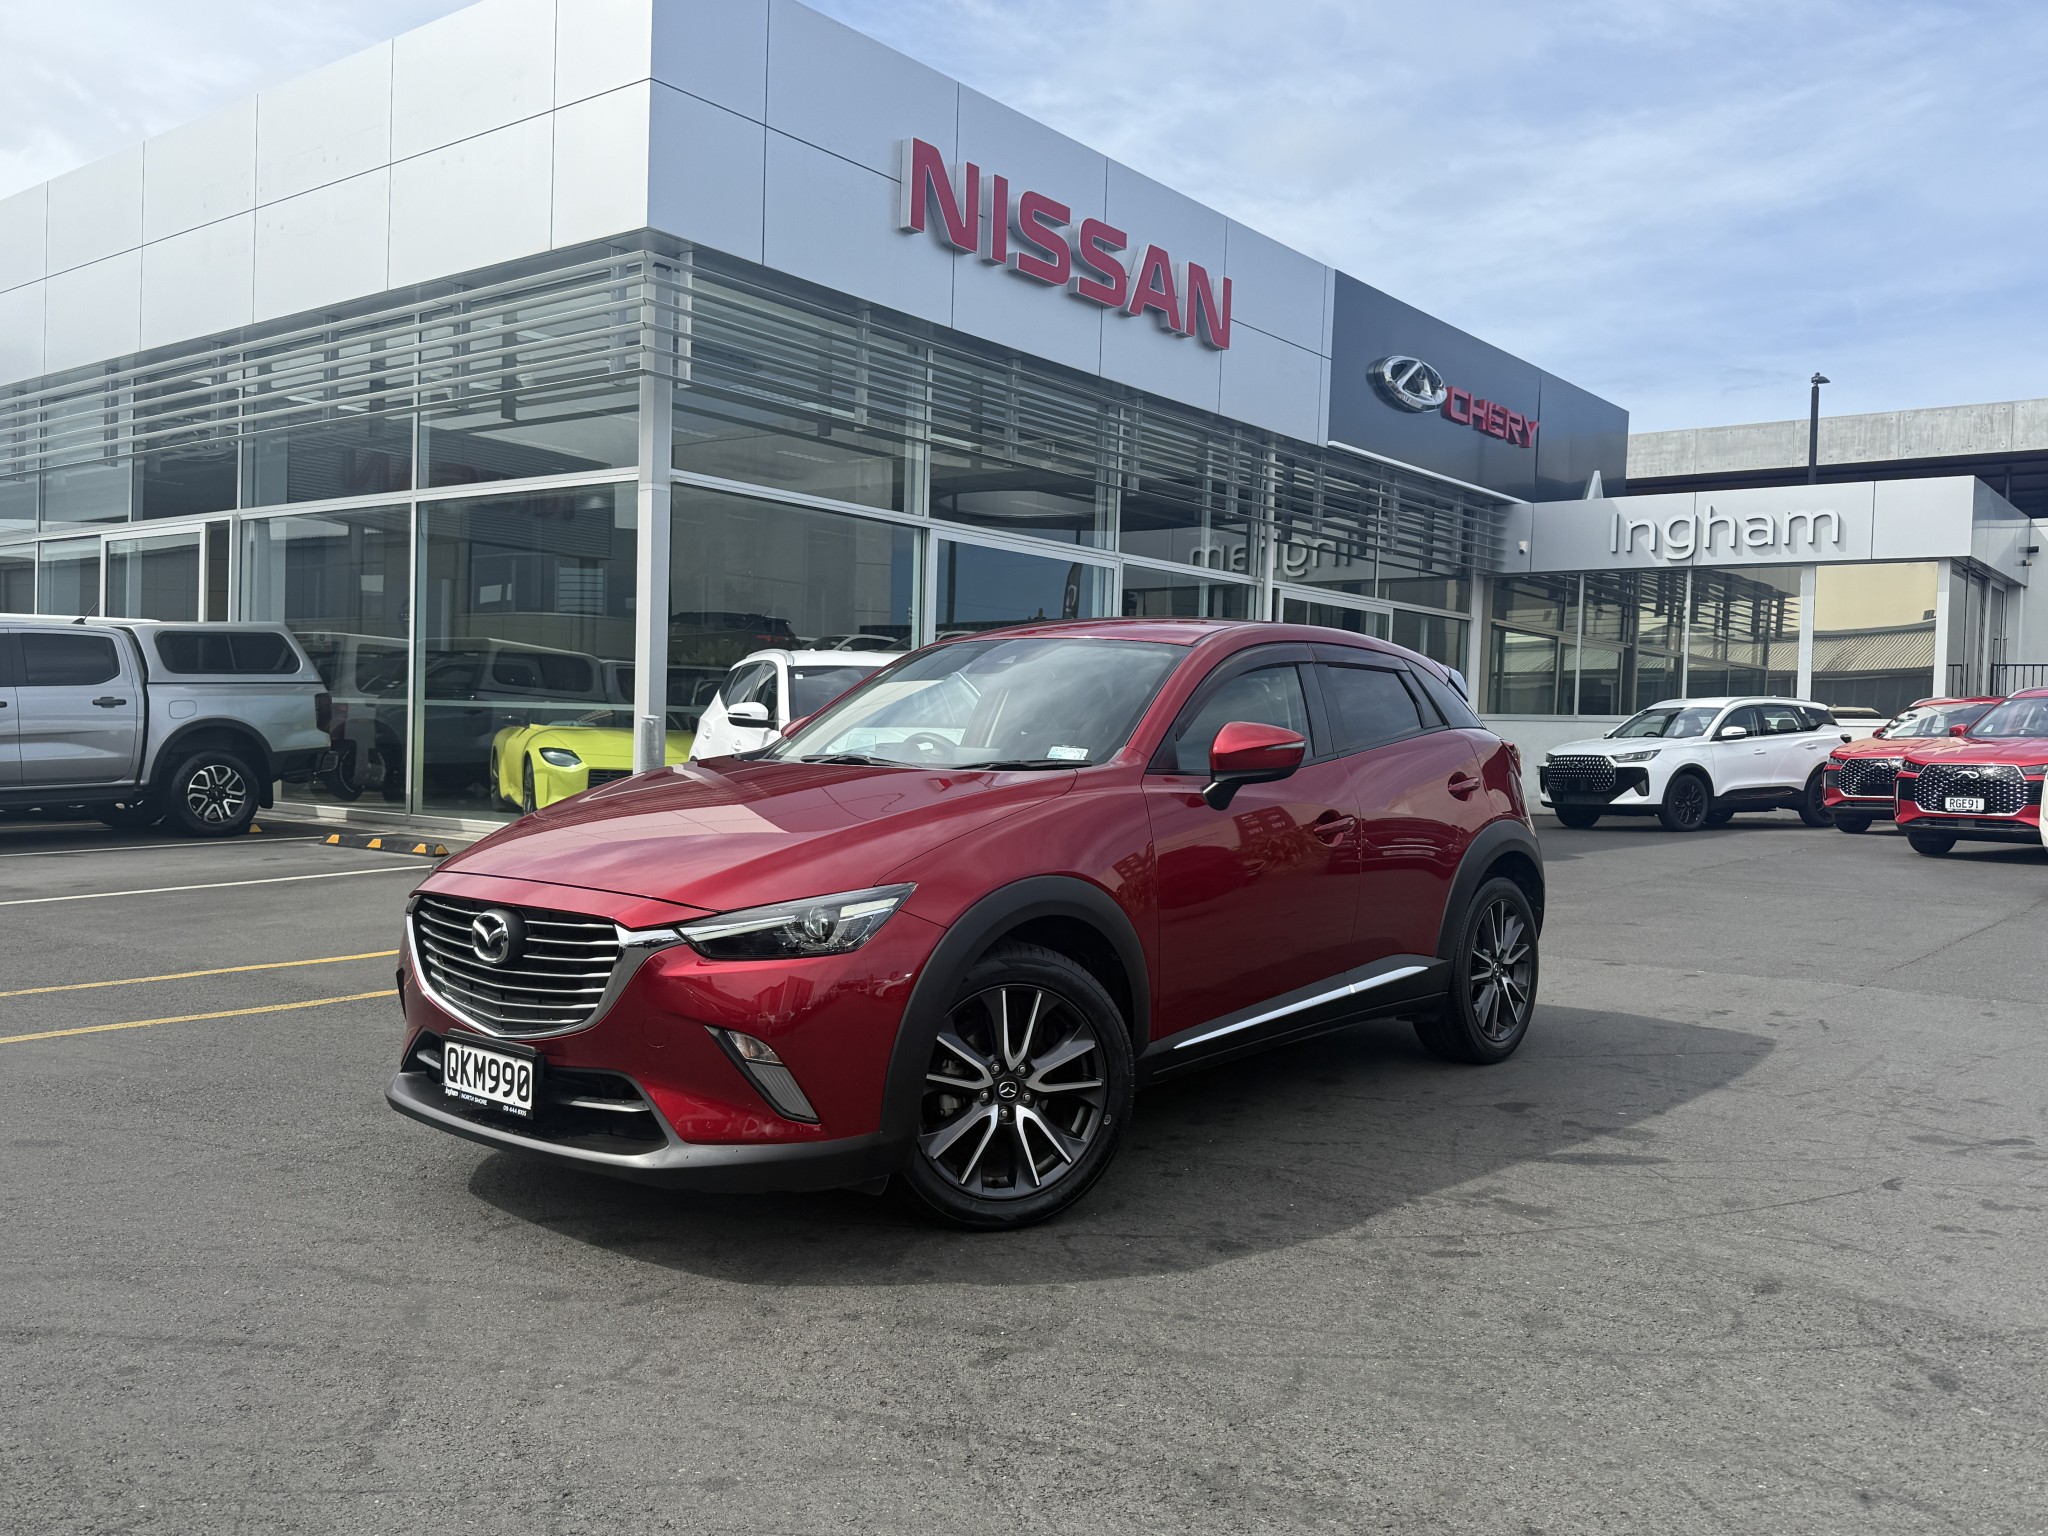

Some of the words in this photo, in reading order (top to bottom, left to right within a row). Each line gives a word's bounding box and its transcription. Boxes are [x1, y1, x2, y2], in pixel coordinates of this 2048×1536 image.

[902, 137, 1232, 350] NISSAN
[1445, 386, 1539, 449] CHERY
[1610, 505, 1840, 560] Ingham
[1949, 798, 1979, 809] RGE91
[447, 1046, 530, 1103] QKM990
